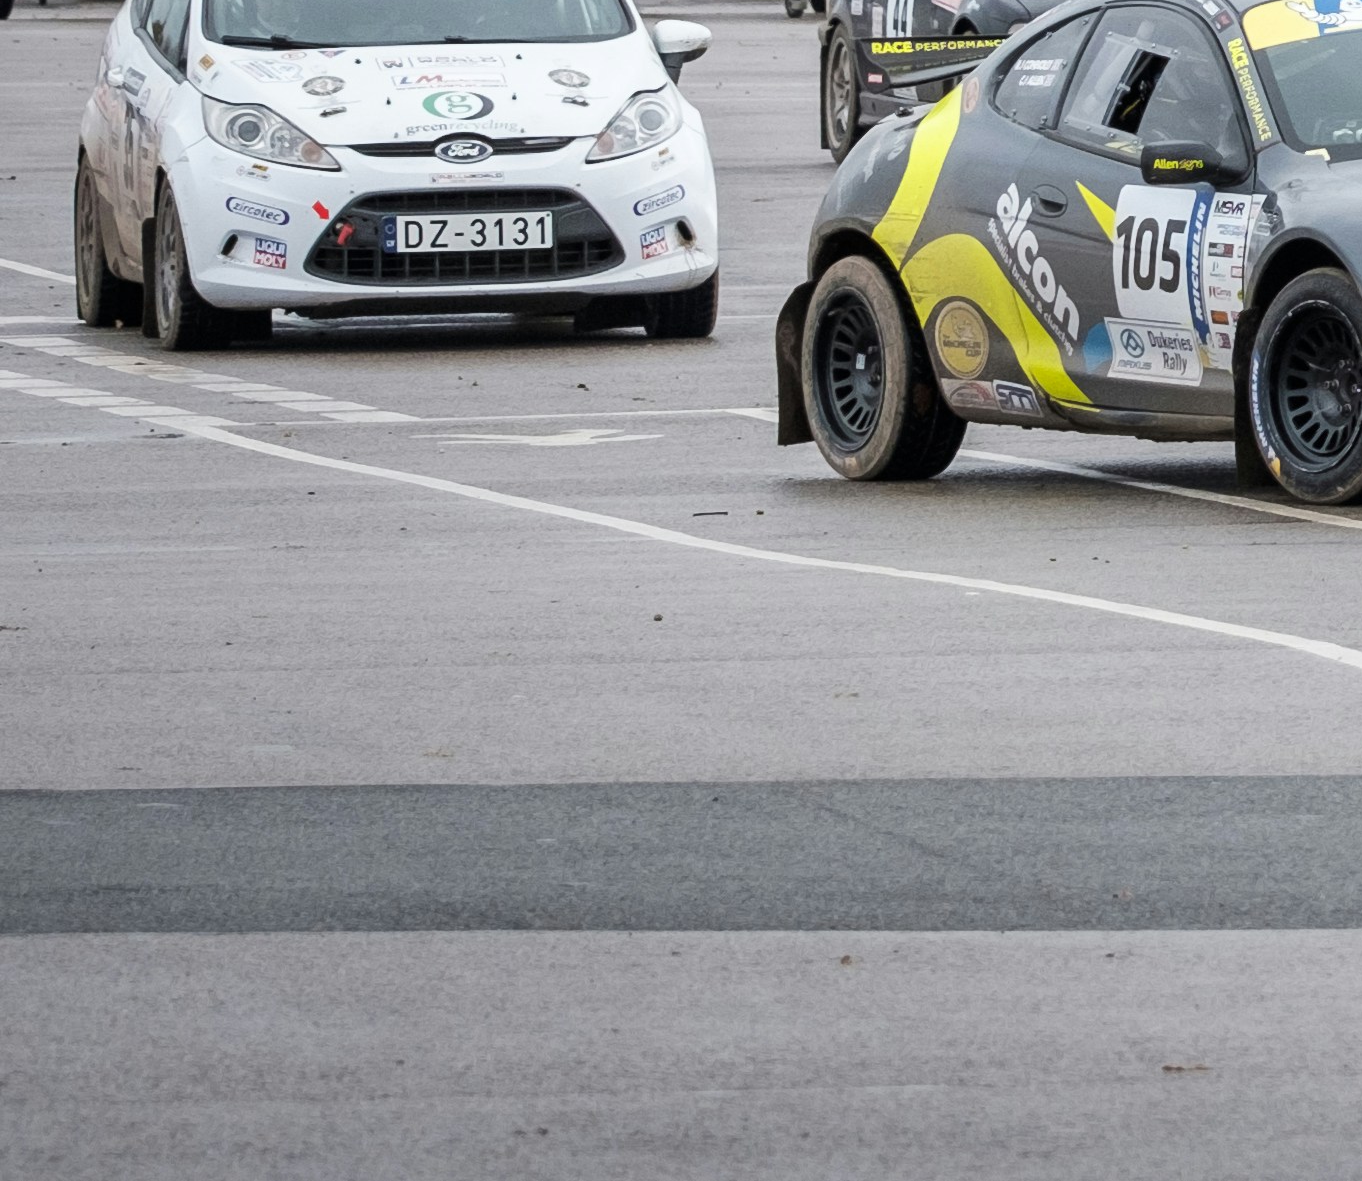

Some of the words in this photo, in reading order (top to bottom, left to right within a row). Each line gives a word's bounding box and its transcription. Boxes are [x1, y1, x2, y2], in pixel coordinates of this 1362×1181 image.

[871, 41, 914, 55] RACE
[915, 39, 1007, 52] PERFORMANC
[1228, 37, 1249, 71] RACE
[1238, 68, 1272, 142] PERFORMANCE
[448, 143, 480, 157] Ford
[233, 202, 281, 221] zircotec
[642, 190, 680, 212] zircotec
[404, 216, 546, 249] DZ-3131
[641, 226, 665, 244] LIQUI
[256, 238, 286, 255] LIQUI
[1117, 216, 1187, 293] 105
[254, 252, 286, 268] MOLY
[996, 182, 1079, 341] alcon
[1192, 202, 1207, 322] MICHELIN
[987, 218, 1012, 268] specialist
[1011, 263, 1035, 303] brakes
[1043, 311, 1074, 356] clutches
[1148, 330, 1193, 352] Dukeries
[1163, 353, 1187, 375] Rally
